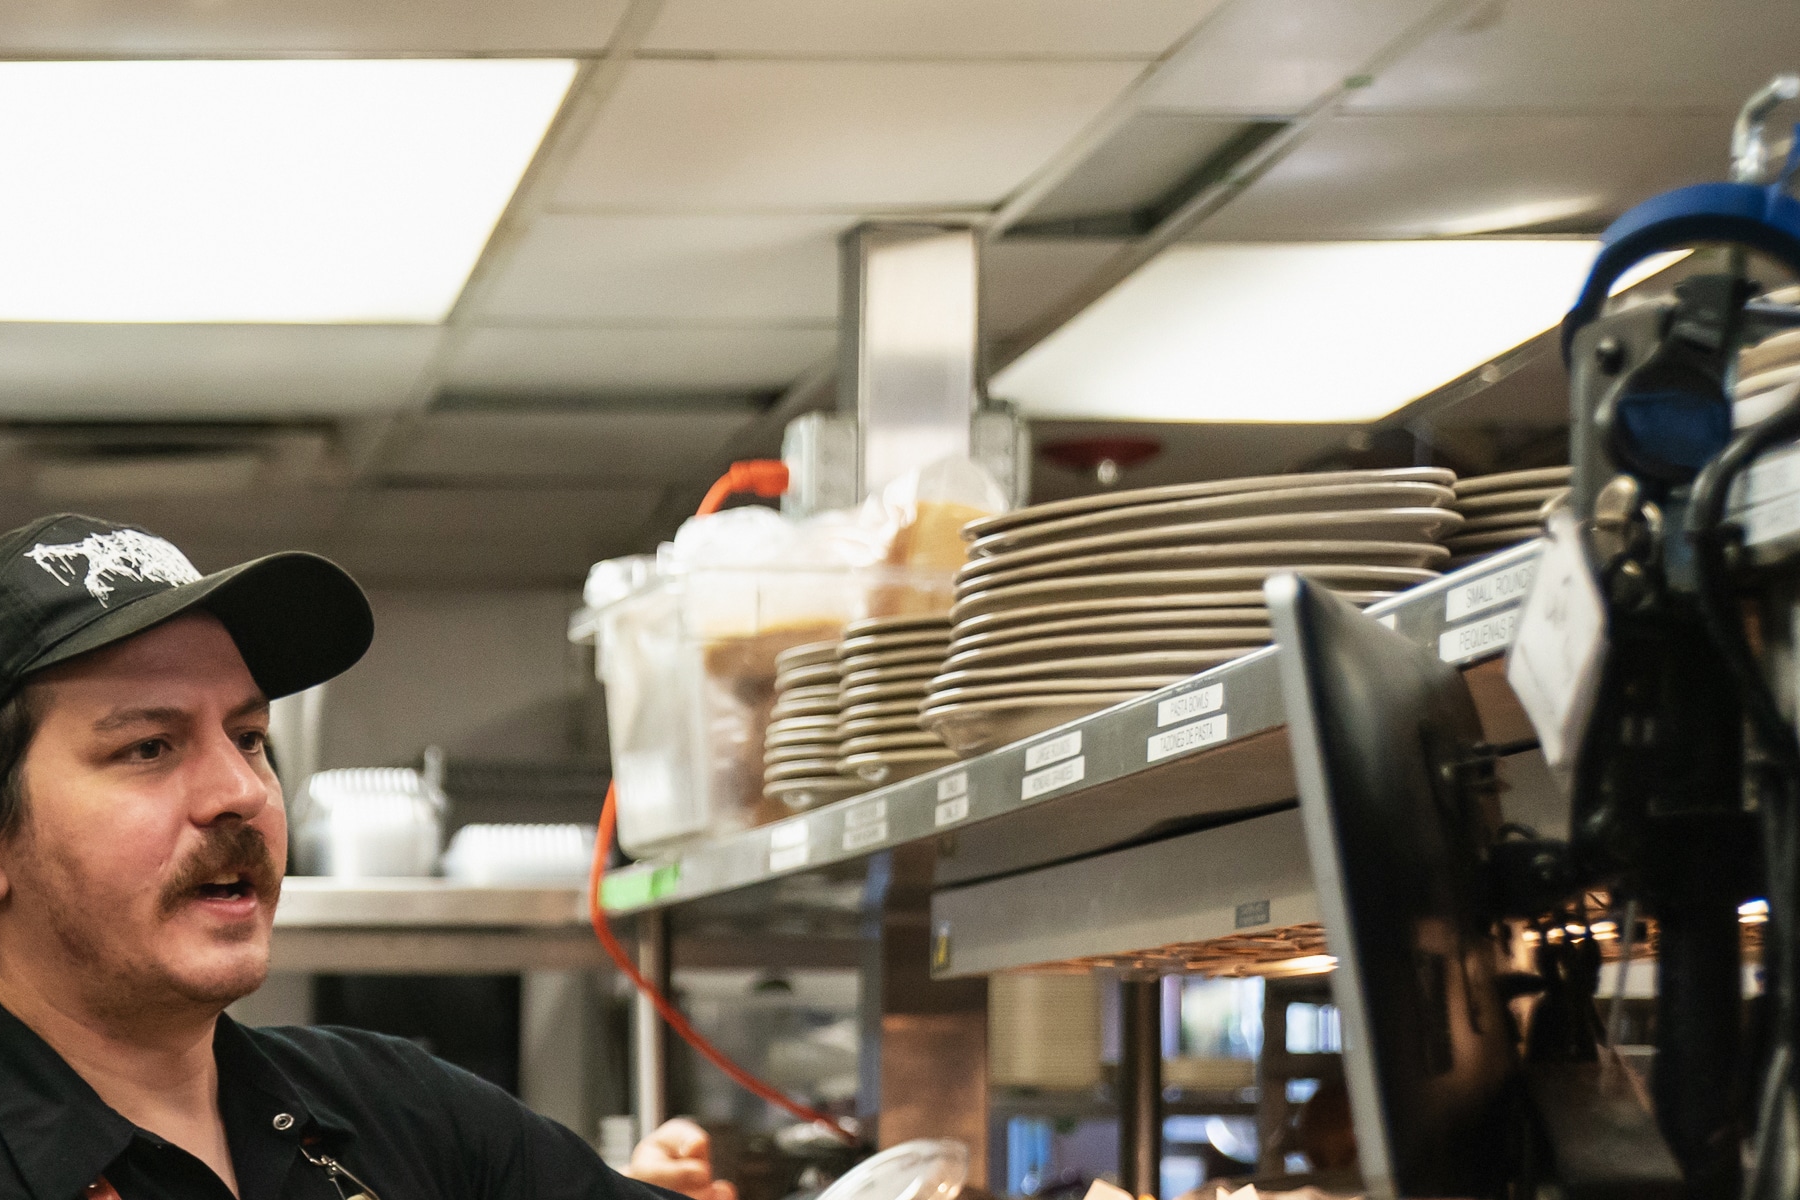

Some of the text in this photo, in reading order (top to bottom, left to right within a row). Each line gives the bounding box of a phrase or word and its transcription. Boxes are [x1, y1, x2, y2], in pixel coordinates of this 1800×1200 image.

[1466, 582, 1493, 608] SMALL
[1170, 691, 1210, 720] PASTA BOWLS
[1194, 723, 1214, 742] PASTA
